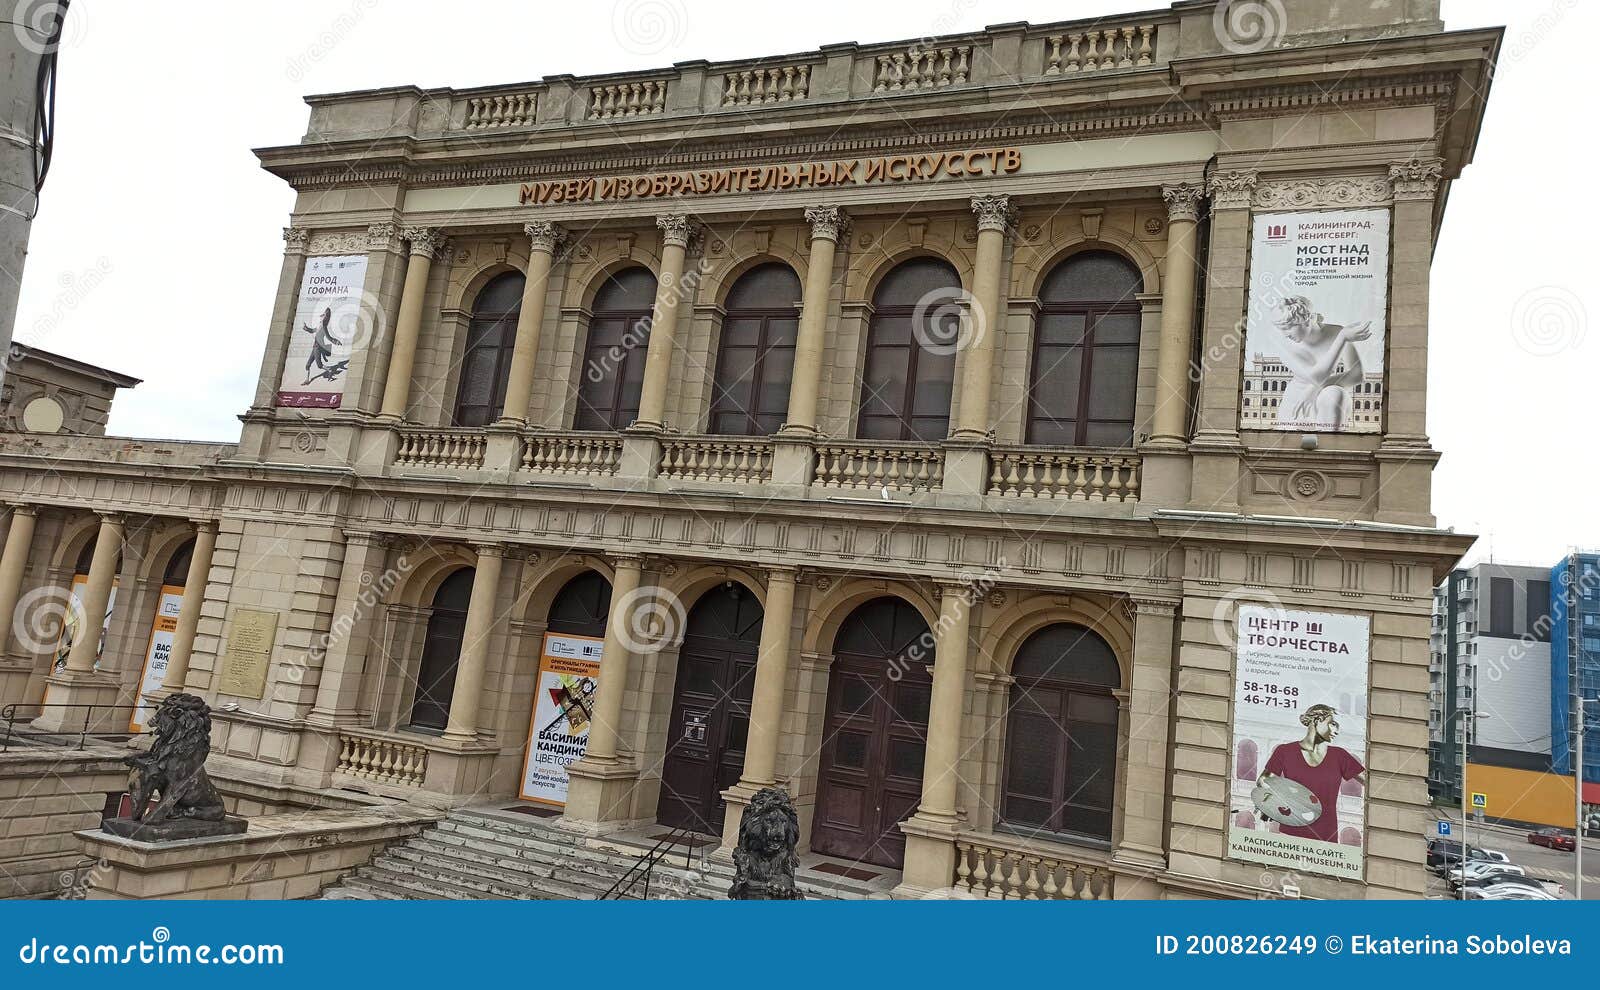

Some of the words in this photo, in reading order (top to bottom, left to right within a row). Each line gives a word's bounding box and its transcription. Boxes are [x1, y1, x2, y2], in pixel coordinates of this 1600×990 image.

[519, 177, 597, 206] МУЗЕЙ
[599, 160, 859, 200] ИЗОБРАЗИТЕЛЬНЫХ
[864, 149, 1022, 184] ИСКУССТВ
[1298, 221, 1374, 230] КАЛИНИНГРАД-
[1298, 231, 1359, 240] КЁНИГСБЕРГ:
[1297, 245, 1336, 255] МОСТ
[1340, 244, 1370, 255] НАД
[1296, 256, 1368, 267] ВРЕМЕНЕМ
[310, 276, 337, 285] ГОРОД
[308, 286, 349, 295] ГОФМАНА
[1248, 617, 1299, 631] ЦЕНТР
[156, 643, 171, 651] ВАС
[1247, 634, 1350, 655] ТВОРЧЕСТВА
[154, 652, 169, 662] КАН
[1243, 681, 1299, 696] 58-18-68
[1244, 694, 1298, 709] 46-71-31
[539, 731, 589, 746] ВАСИЛИЙ
[537, 742, 586, 757] КАНДИНС
[533, 772, 550, 781] Музей
[532, 780, 556, 788] искусств
[1441, 822, 1449, 832] P
[1244, 836, 1300, 852] РАСПИСАНИЕ
[1302, 846, 1314, 854] НА
[1316, 848, 1346, 860] САЙТЕ:
[1232, 843, 1359, 871] KALININGRADARTMUSEUM.RU
